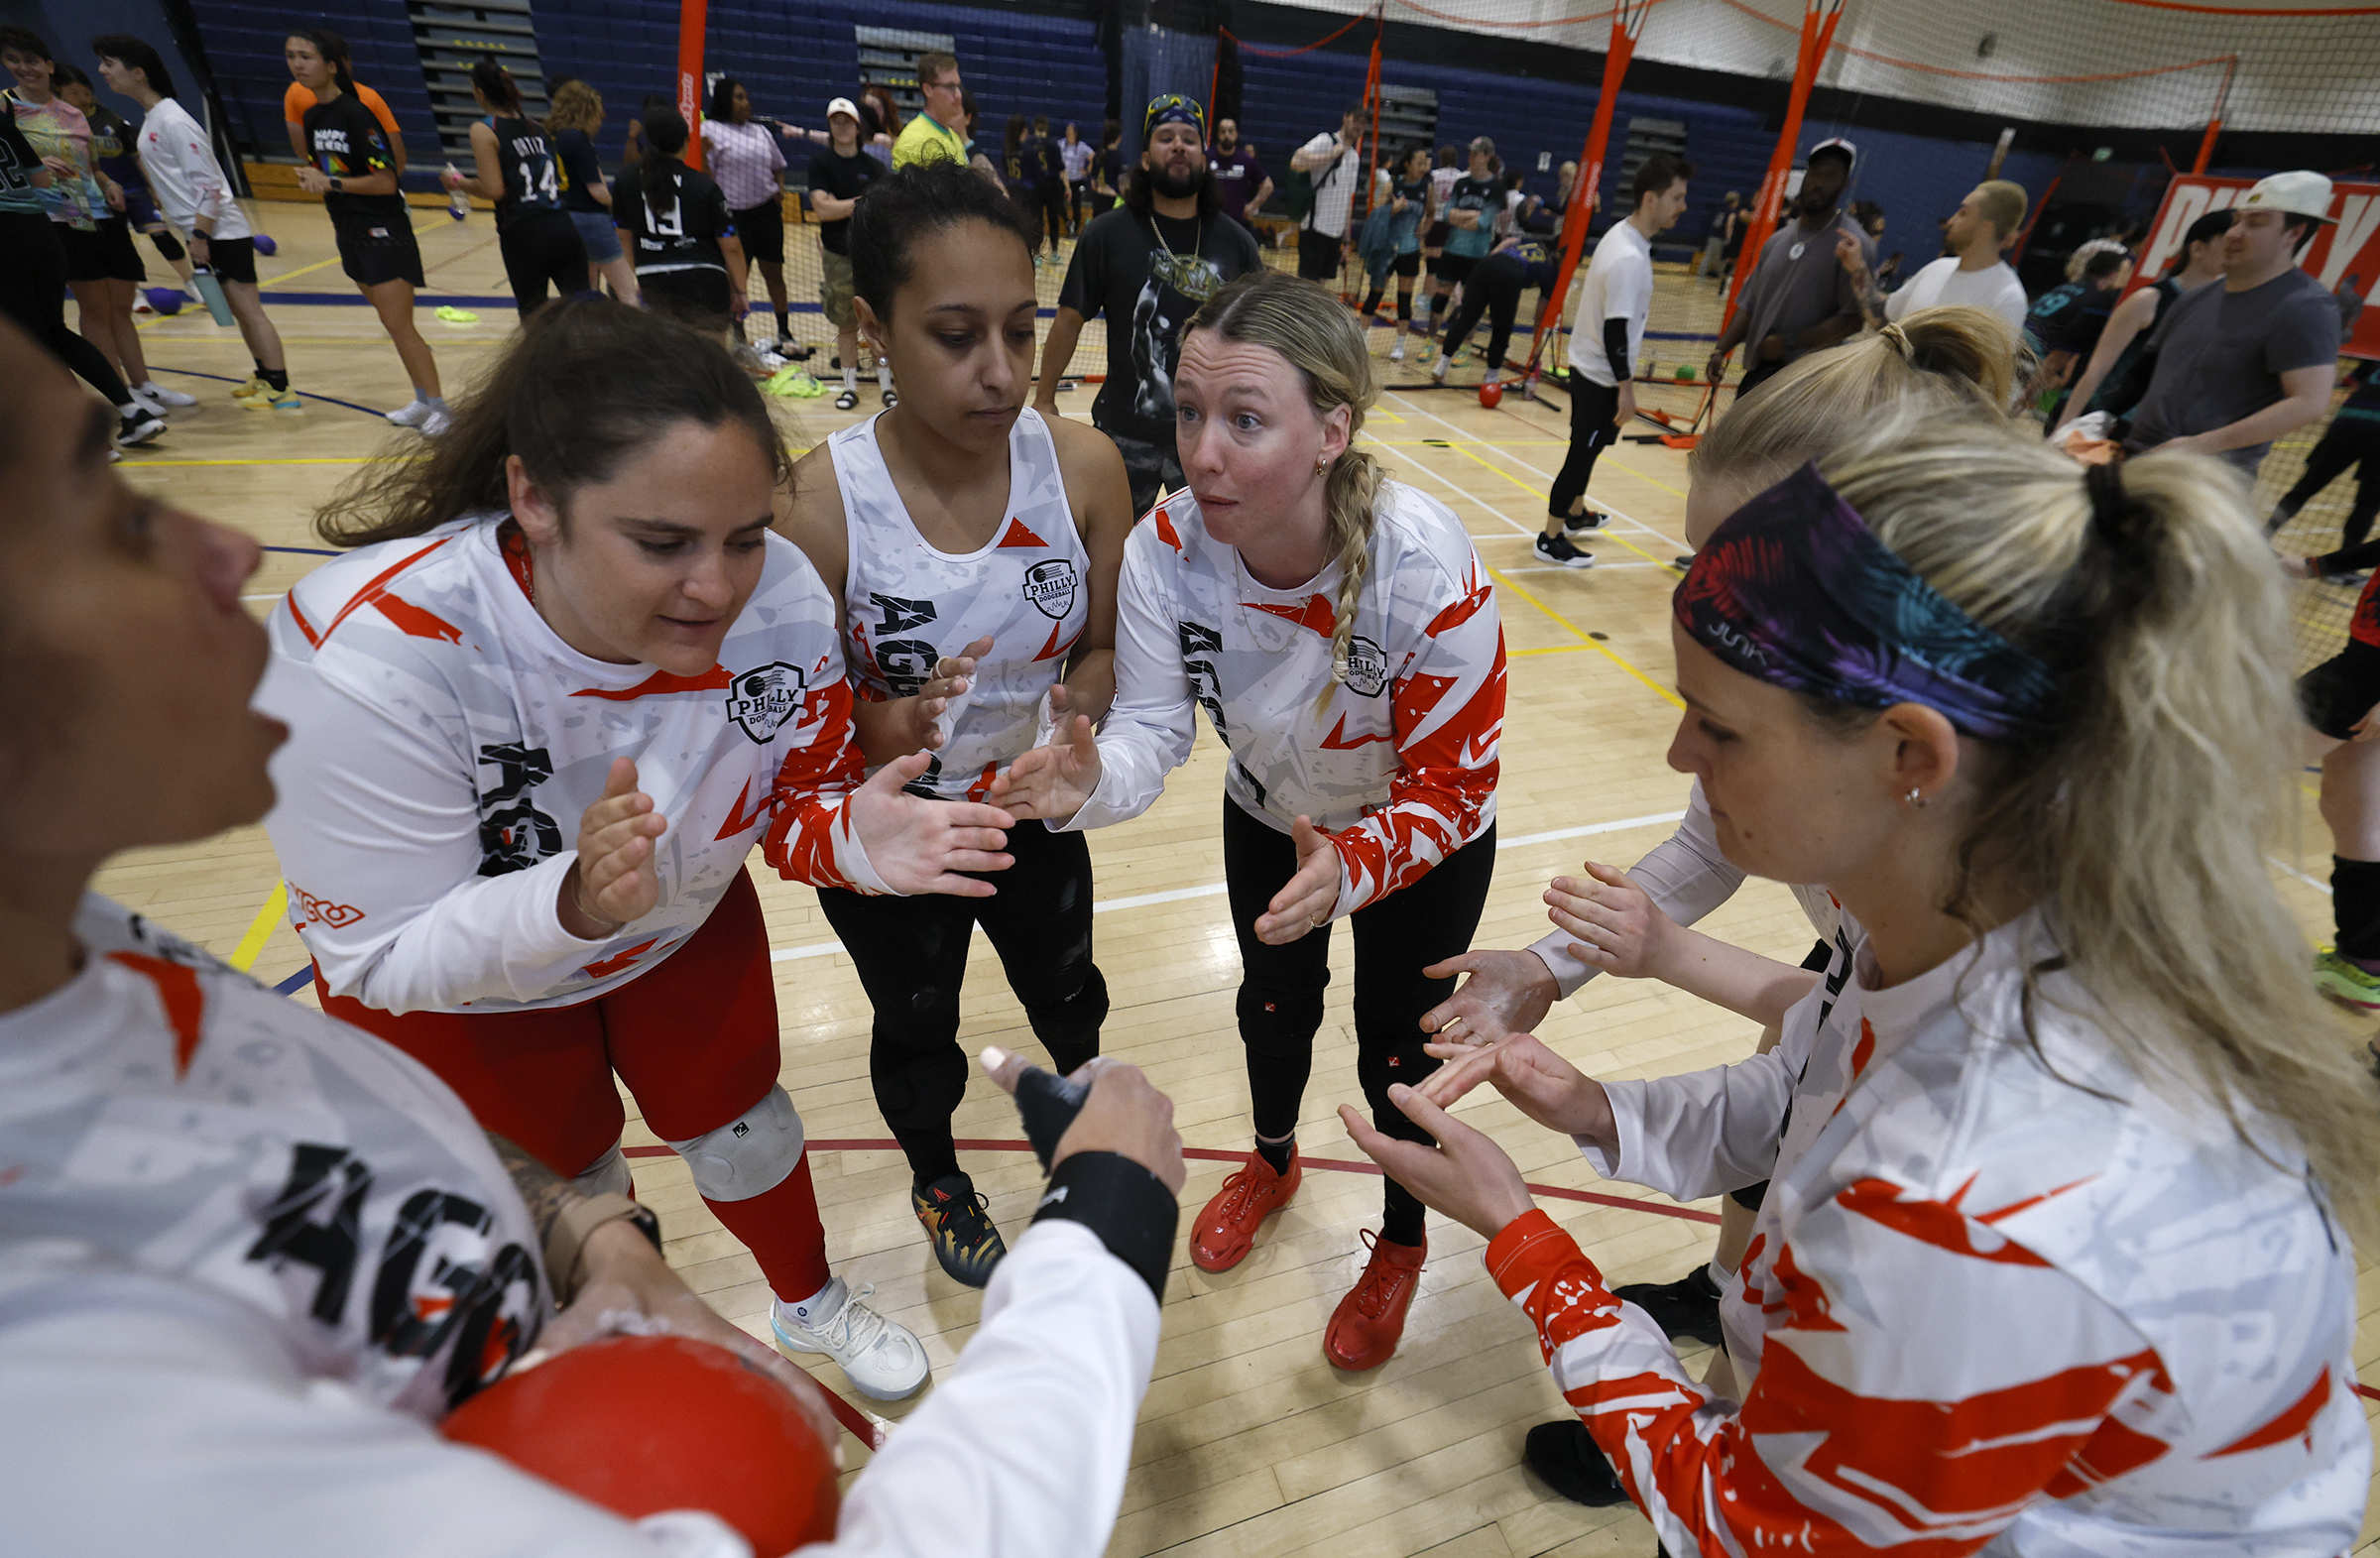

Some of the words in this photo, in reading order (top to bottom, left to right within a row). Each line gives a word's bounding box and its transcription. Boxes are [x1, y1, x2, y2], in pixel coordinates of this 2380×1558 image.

[519, 160, 559, 202] 14
[1030, 575, 1072, 596] PHILLY
[1039, 589, 1071, 602] DODGEBALL
[1708, 622, 1767, 665] JUNK
[1348, 658, 1385, 679] HILLY
[750, 705, 787, 724] DODBALL
